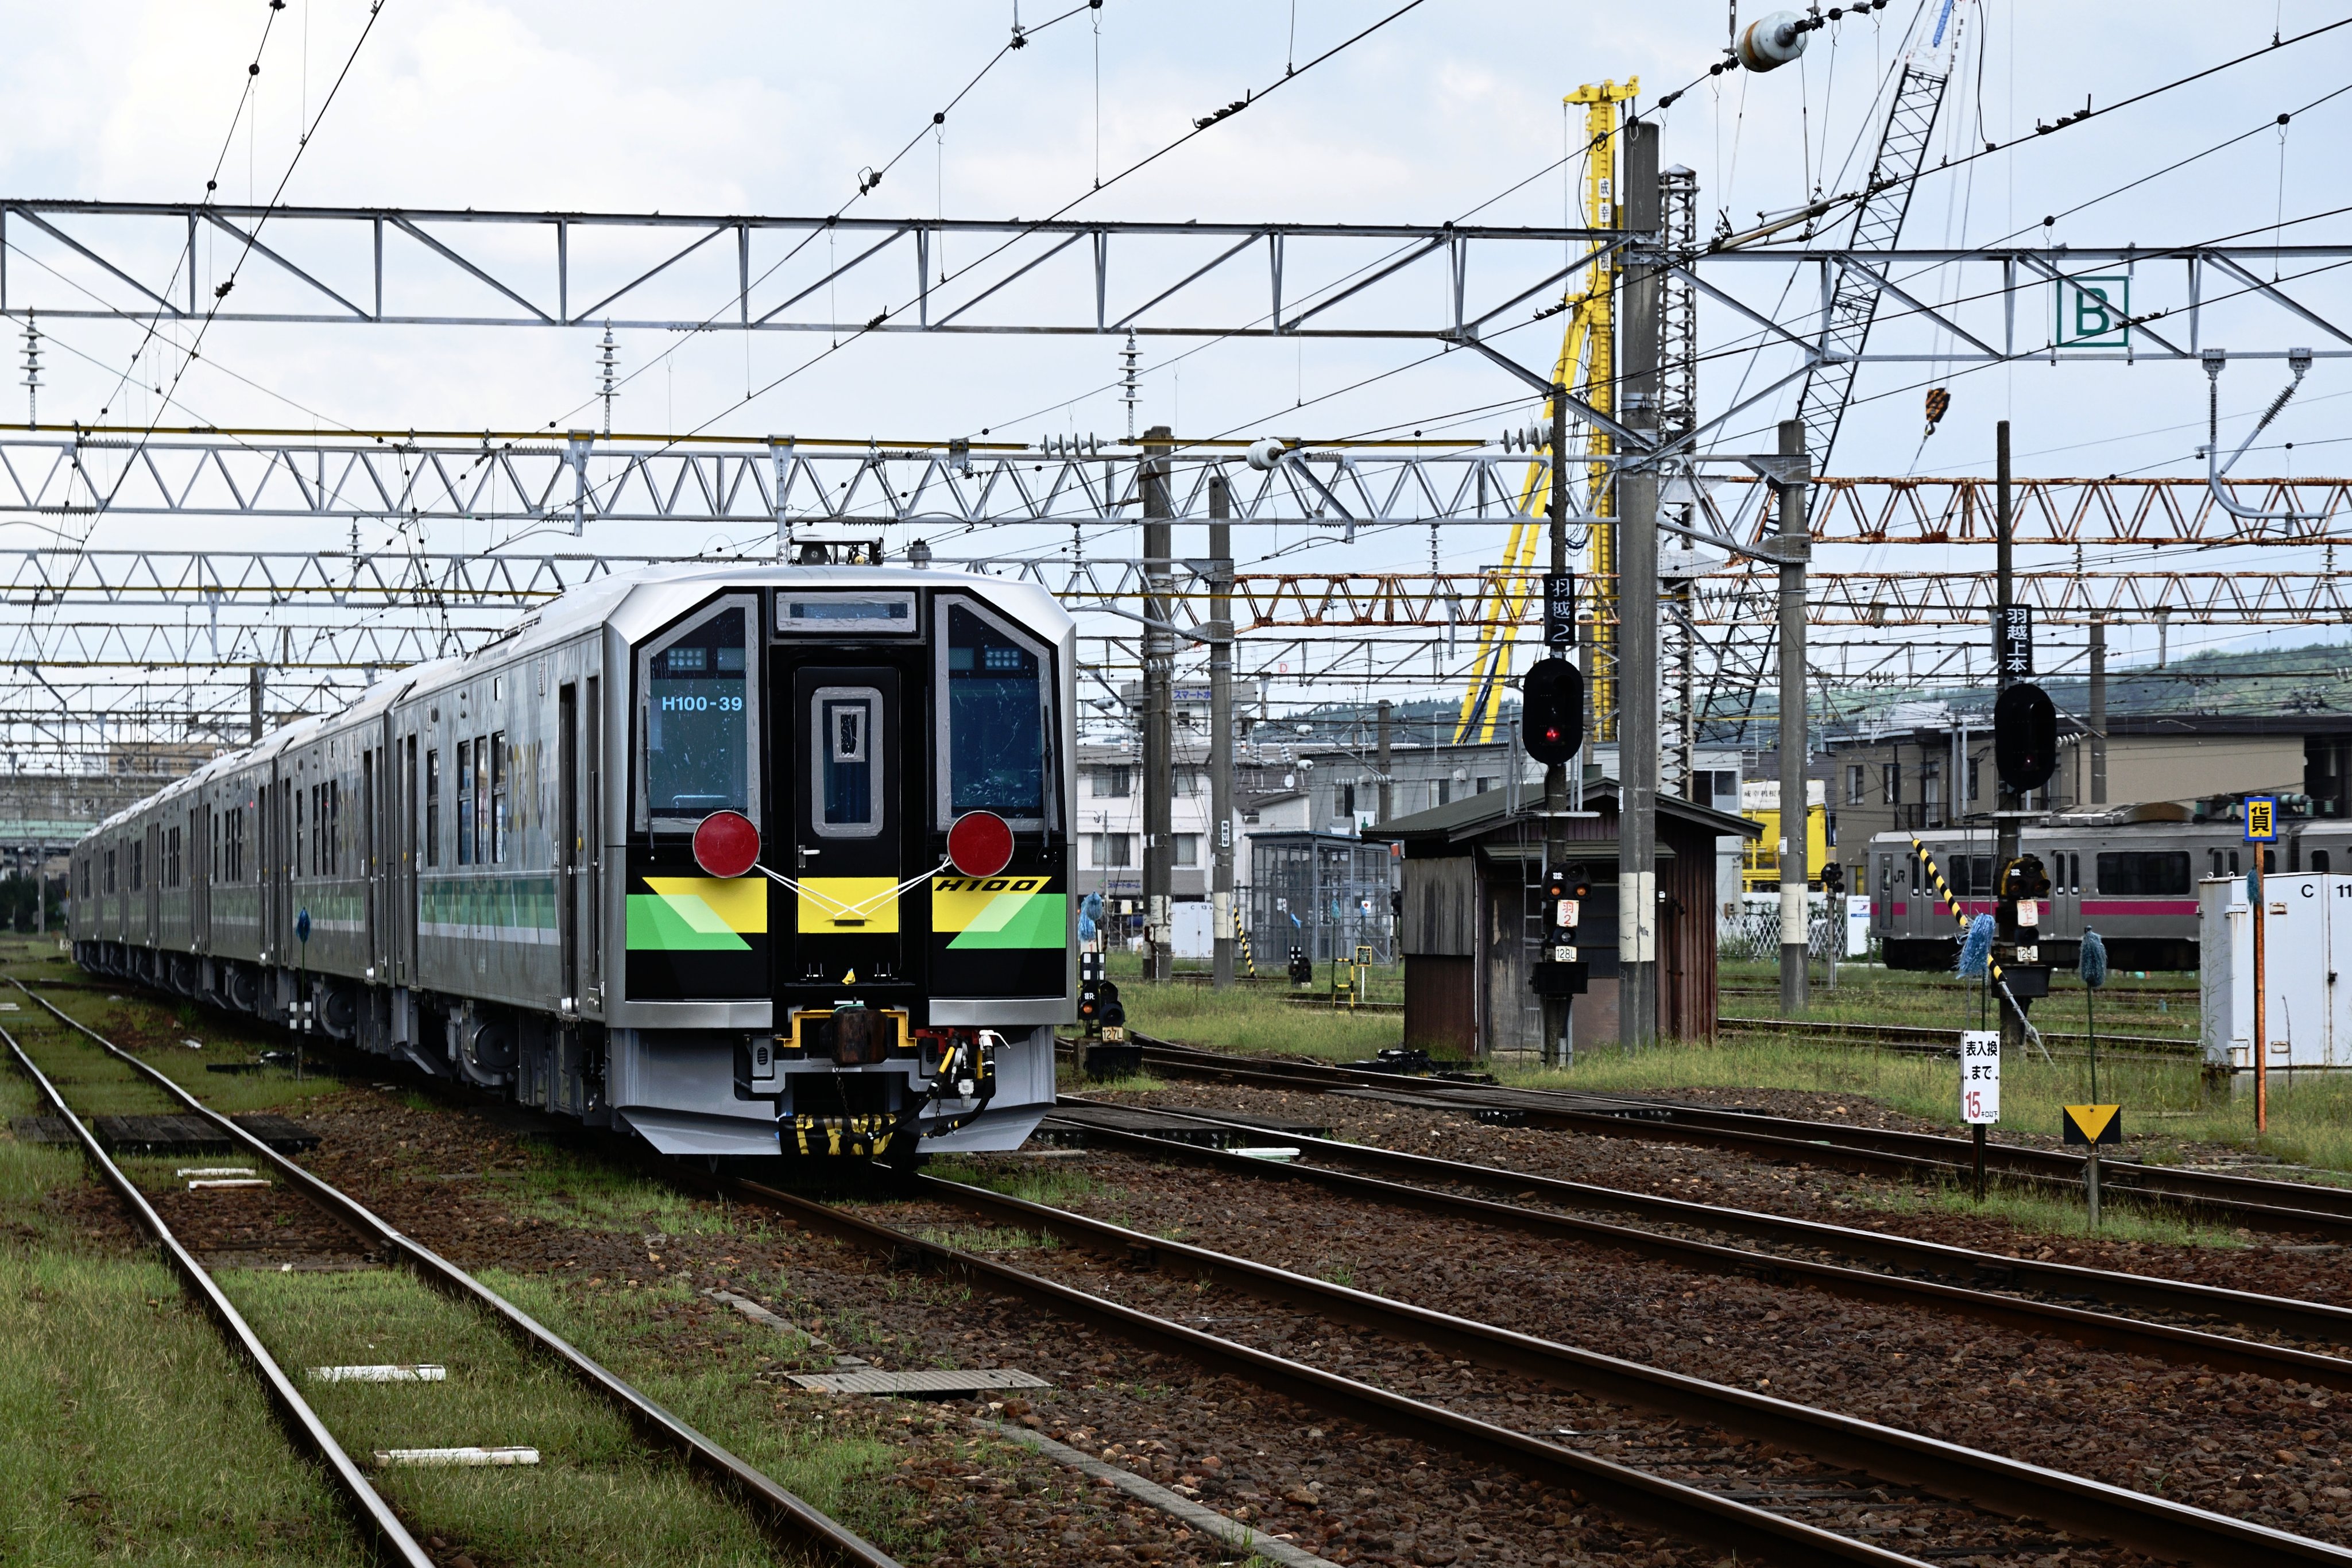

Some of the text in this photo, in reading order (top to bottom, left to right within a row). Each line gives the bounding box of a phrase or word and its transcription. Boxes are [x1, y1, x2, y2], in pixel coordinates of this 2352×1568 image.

[2076, 288, 2110, 336] B
[1550, 578, 1570, 642] 羽越2
[2006, 609, 2028, 672] 羽越上本
[662, 696, 742, 711] H100-39
[2251, 806, 2270, 833] 貨
[1894, 870, 1905, 883] JR
[934, 880, 1039, 891] H100
[2301, 884, 2314, 898] C
[2022, 902, 2033, 925] 羽上
[1557, 948, 1576, 959] 128L
[2018, 948, 2037, 959] 129L
[1102, 1029, 1122, 1040] 127L
[1966, 1040, 1998, 1057] 表入換
[1972, 1065, 1992, 1080] まで
[1966, 1091, 1980, 1118] 15
